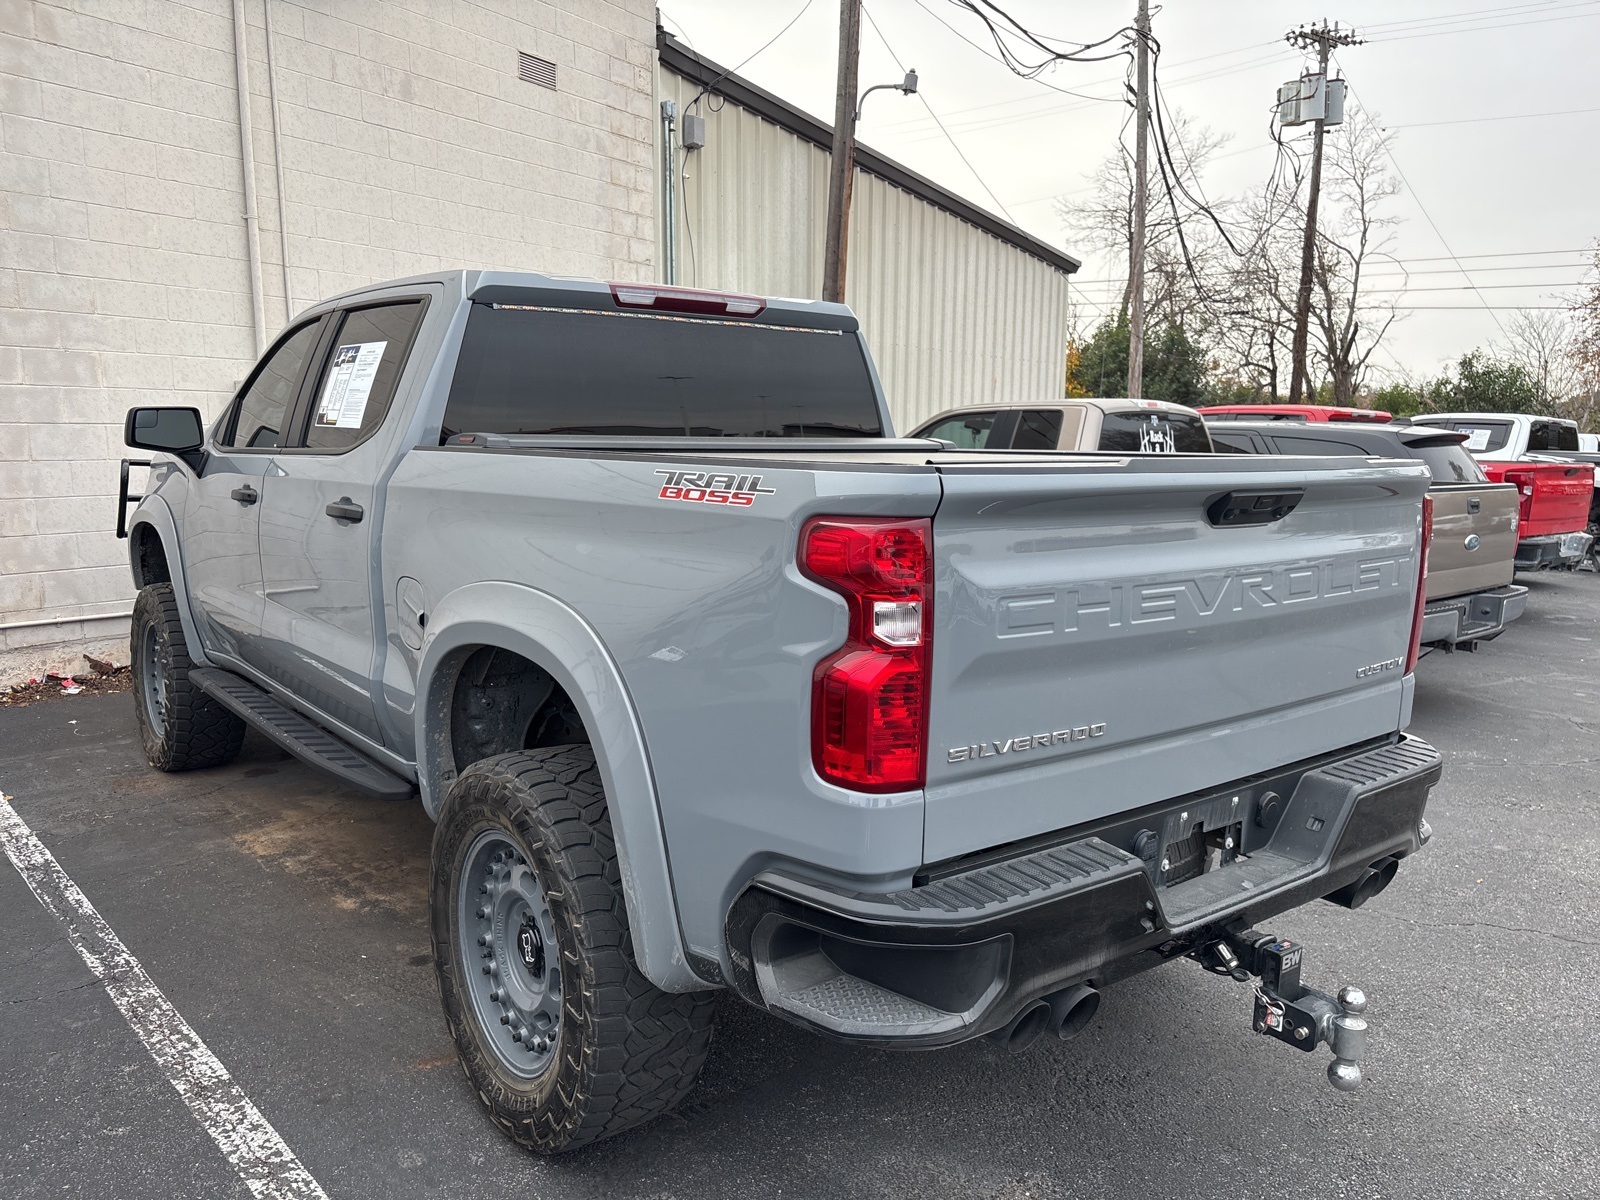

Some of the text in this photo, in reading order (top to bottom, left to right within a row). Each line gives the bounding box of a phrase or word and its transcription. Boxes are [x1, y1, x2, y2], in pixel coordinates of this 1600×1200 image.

[654, 469, 776, 495] TRAIL
[658, 485, 756, 507] BOSS
[997, 554, 1410, 640] CHEVROLET
[1356, 656, 1404, 679] CUSTOM
[947, 722, 1106, 763] SILVERADO
